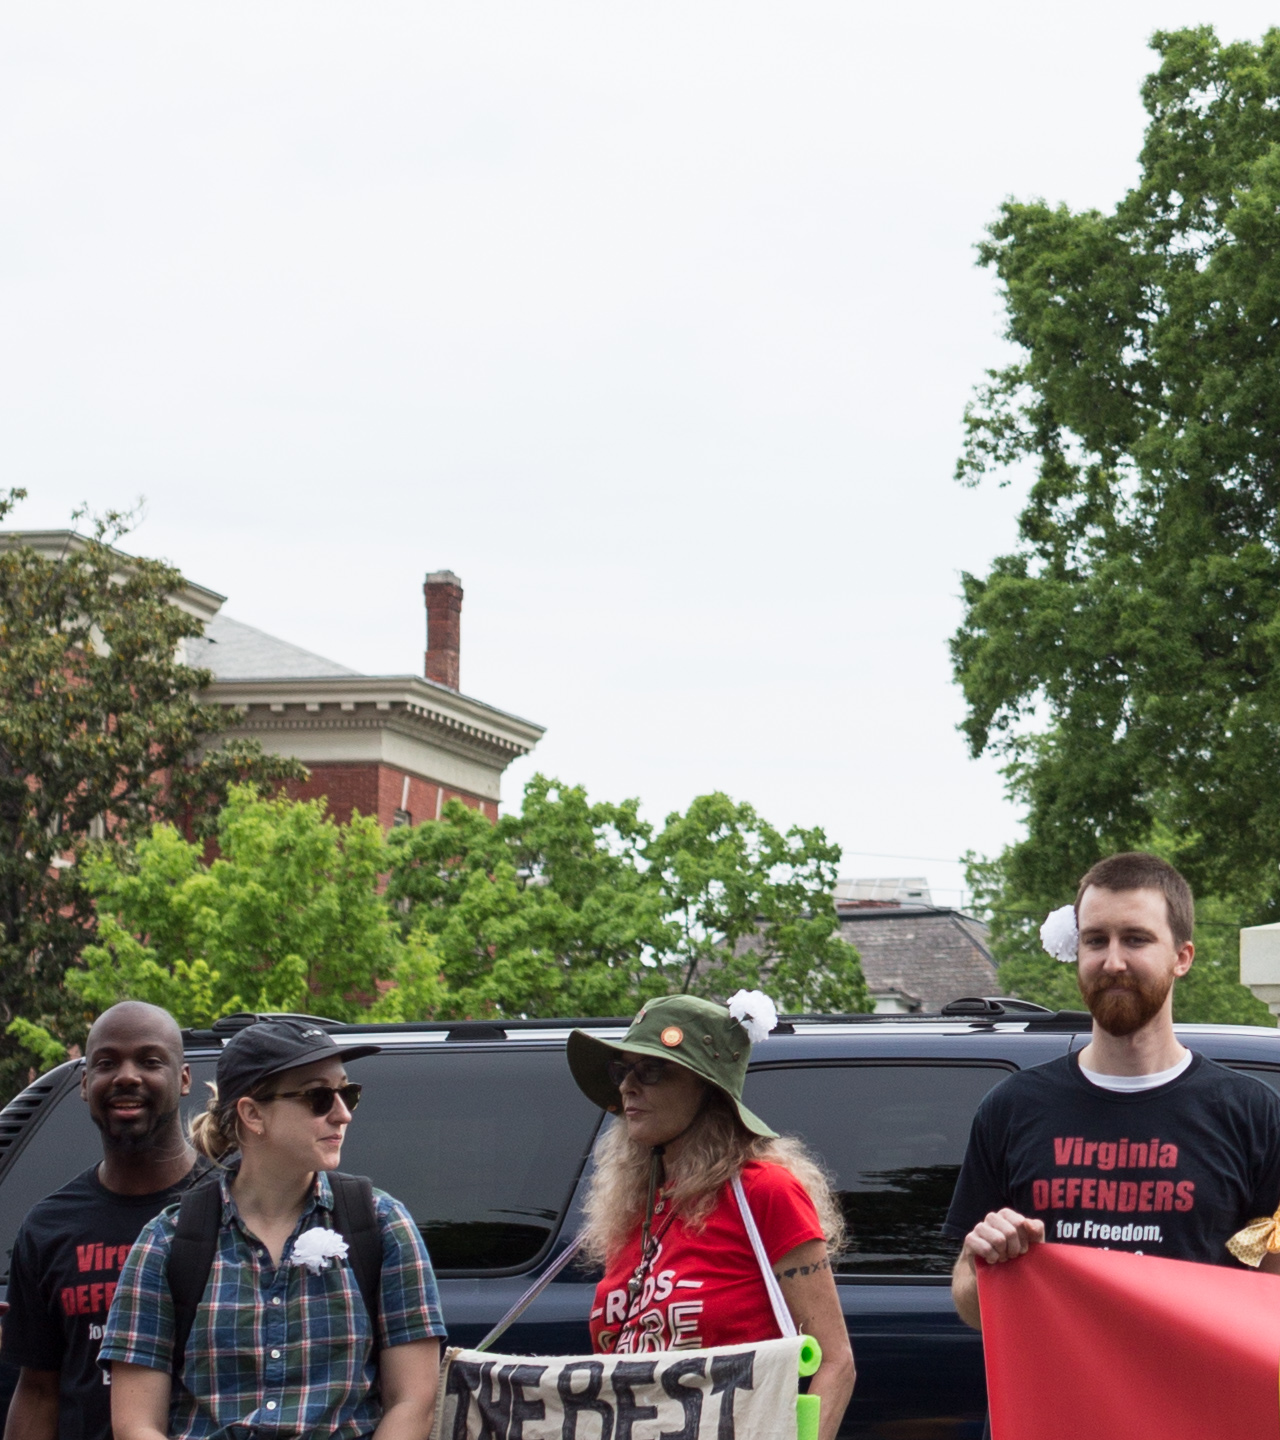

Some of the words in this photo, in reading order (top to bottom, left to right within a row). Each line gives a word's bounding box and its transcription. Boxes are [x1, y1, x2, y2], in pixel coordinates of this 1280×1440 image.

[1053, 1137, 1179, 1171] Virginia
[1032, 1178, 1196, 1213] DEFENDERS
[1056, 1219, 1081, 1239] for
[1083, 1220, 1163, 1244] Freedom,
